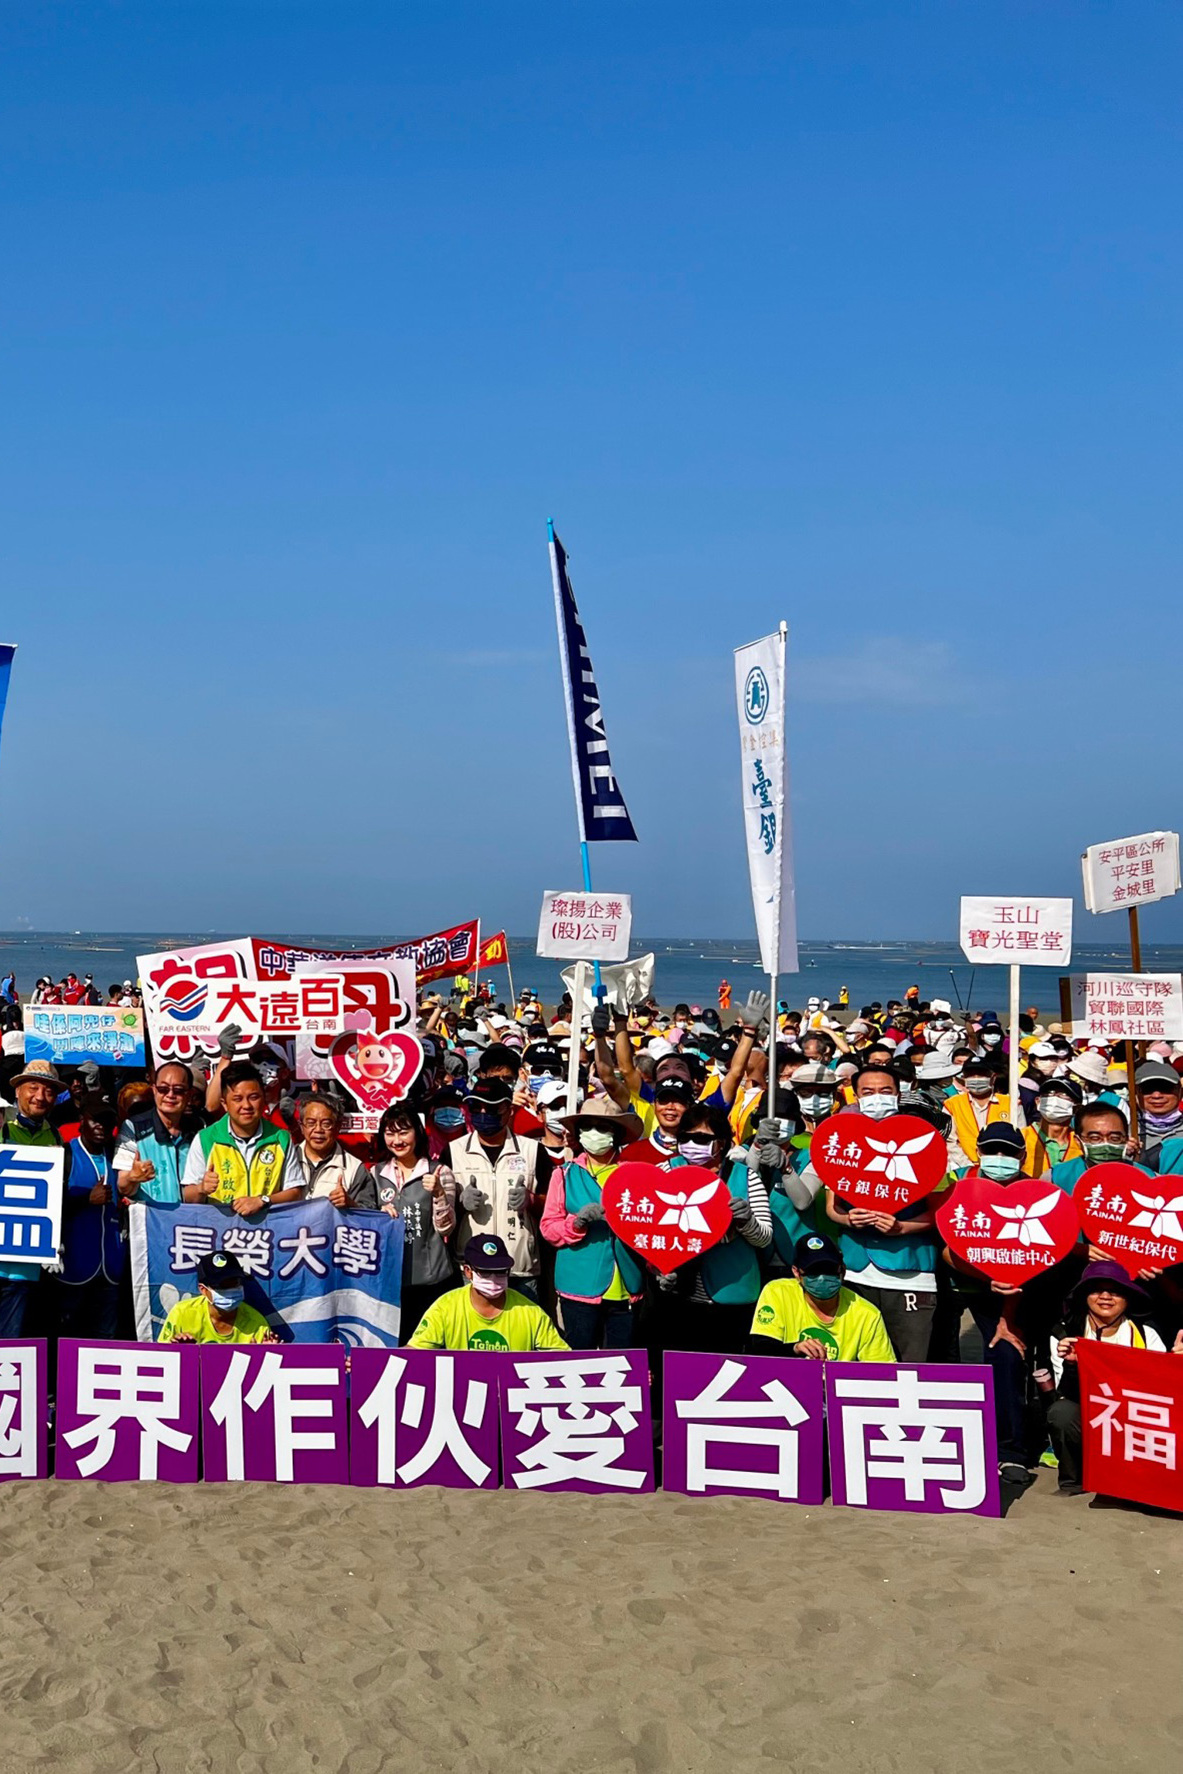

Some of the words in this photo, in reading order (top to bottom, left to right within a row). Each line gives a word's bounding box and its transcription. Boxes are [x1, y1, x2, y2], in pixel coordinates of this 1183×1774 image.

[1098, 838, 1166, 866] 安平區公所
[1111, 859, 1155, 881] 平安里
[1112, 879, 1156, 902] 金城里
[550, 900, 623, 920] 璨揚企業
[992, 906, 1039, 925] 玉山
[552, 921, 618, 942] (股)公司
[968, 929, 1064, 952] 寶光聖堂
[1077, 981, 1173, 997] 河川巡守隊
[215, 977, 342, 1031] 大遠百
[1088, 1000, 1165, 1016] 貿聯國際
[158, 1025, 174, 1033] FAR
[176, 1024, 211, 1033] EASTERN
[305, 1018, 338, 1031] 台南
[1088, 1019, 1165, 1036] 林鳳社區
[821, 1130, 863, 1160] 臺南
[823, 1155, 860, 1169] TAINAN
[836, 1176, 910, 1204] 台銀保代
[1083, 1183, 1127, 1214] 臺南
[615, 1187, 655, 1215] 臺南
[619, 1213, 654, 1224] TAINAN
[949, 1203, 992, 1230] 臺南
[1085, 1208, 1123, 1223] TAINAN
[633, 1233, 702, 1254] 臺銀人壽
[953, 1229, 991, 1239] TAINAN
[169, 1225, 378, 1278] 長榮大學
[966, 1246, 1056, 1267] 朝興啟能中心
[1097, 1230, 1178, 1262] 新世紀保代
[904, 1292, 918, 1312] R
[1088, 1381, 1177, 1471] 福
